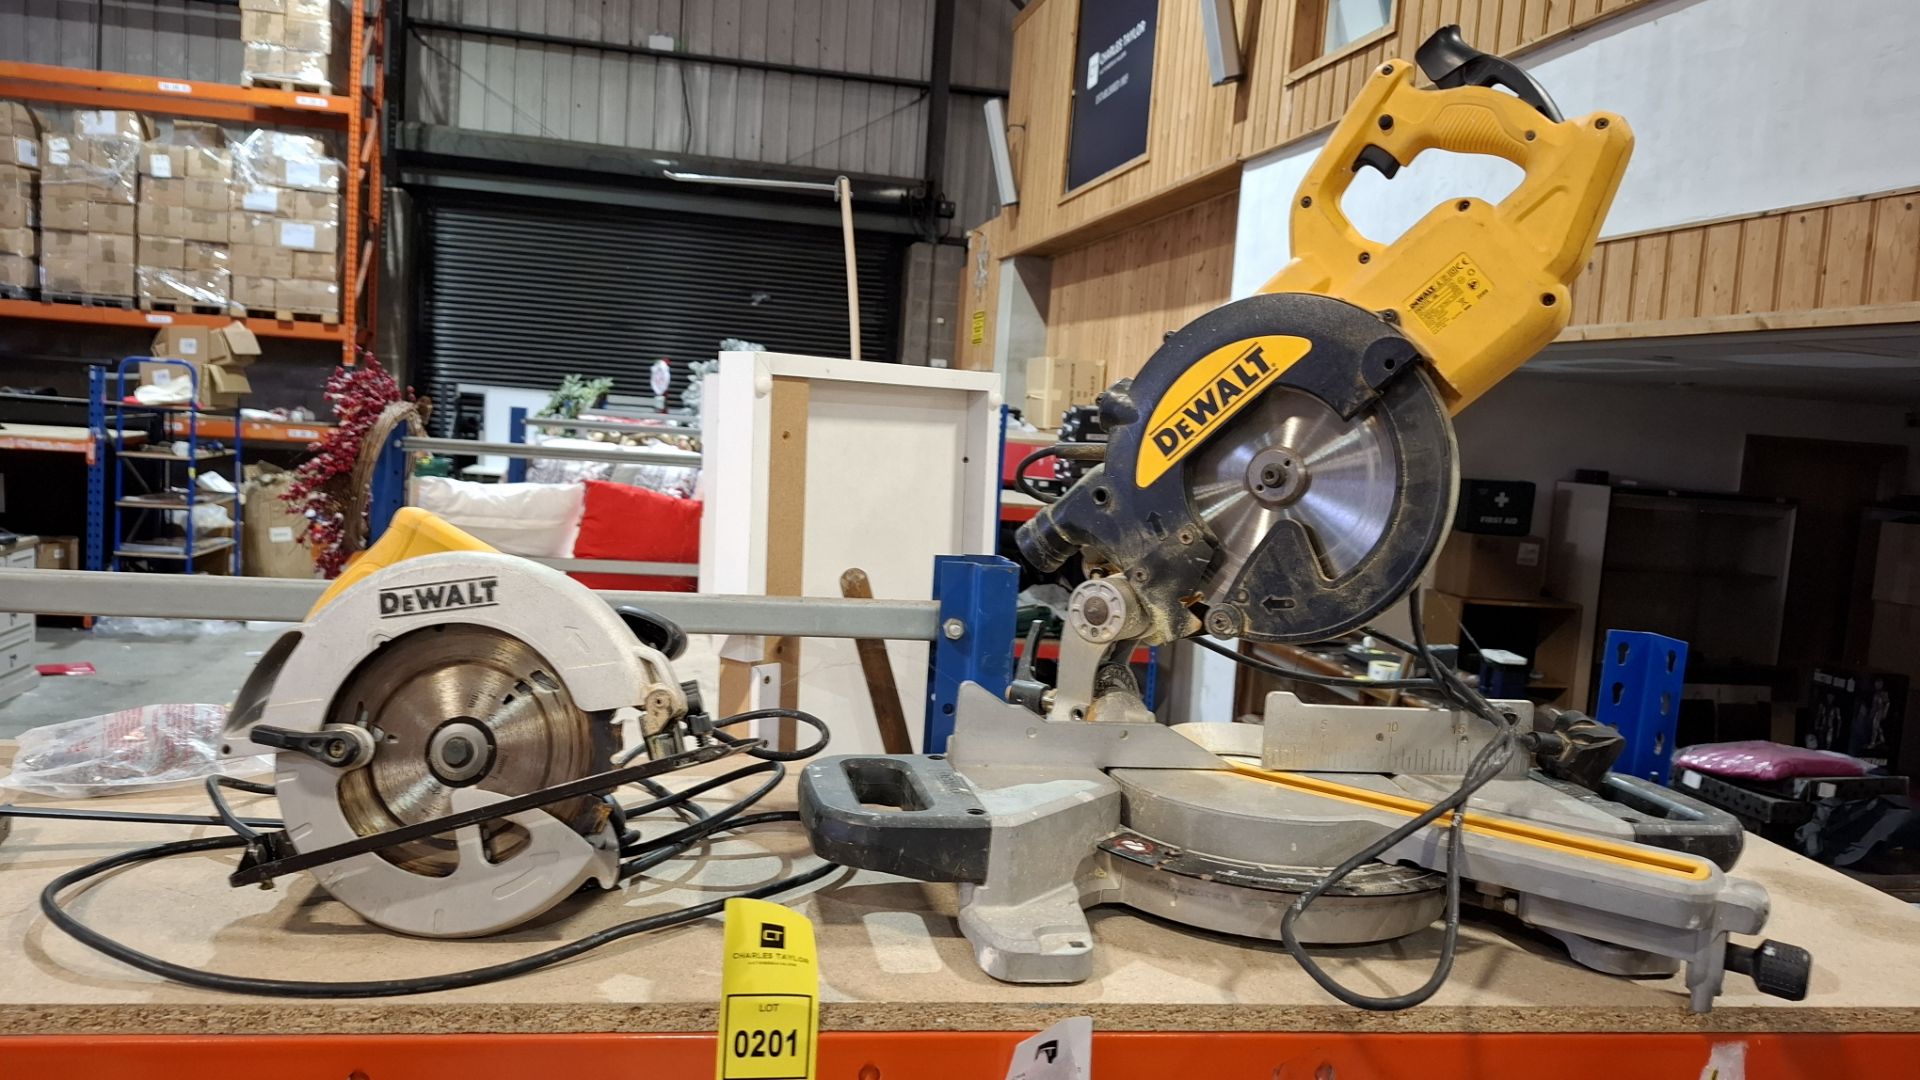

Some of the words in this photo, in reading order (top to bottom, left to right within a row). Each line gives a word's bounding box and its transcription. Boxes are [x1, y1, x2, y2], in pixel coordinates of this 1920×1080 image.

[1151, 346, 1272, 457] DEWALT
[1480, 516, 1503, 524] FIRST
[1504, 517, 1518, 525] AID
[380, 580, 498, 615] DEWALT
[1387, 721, 1399, 732] 10
[732, 952, 773, 960] CHARLES
[775, 953, 809, 963] TAYLOR
[759, 1003, 779, 1012] LOT
[734, 1029, 797, 1058] 0201
